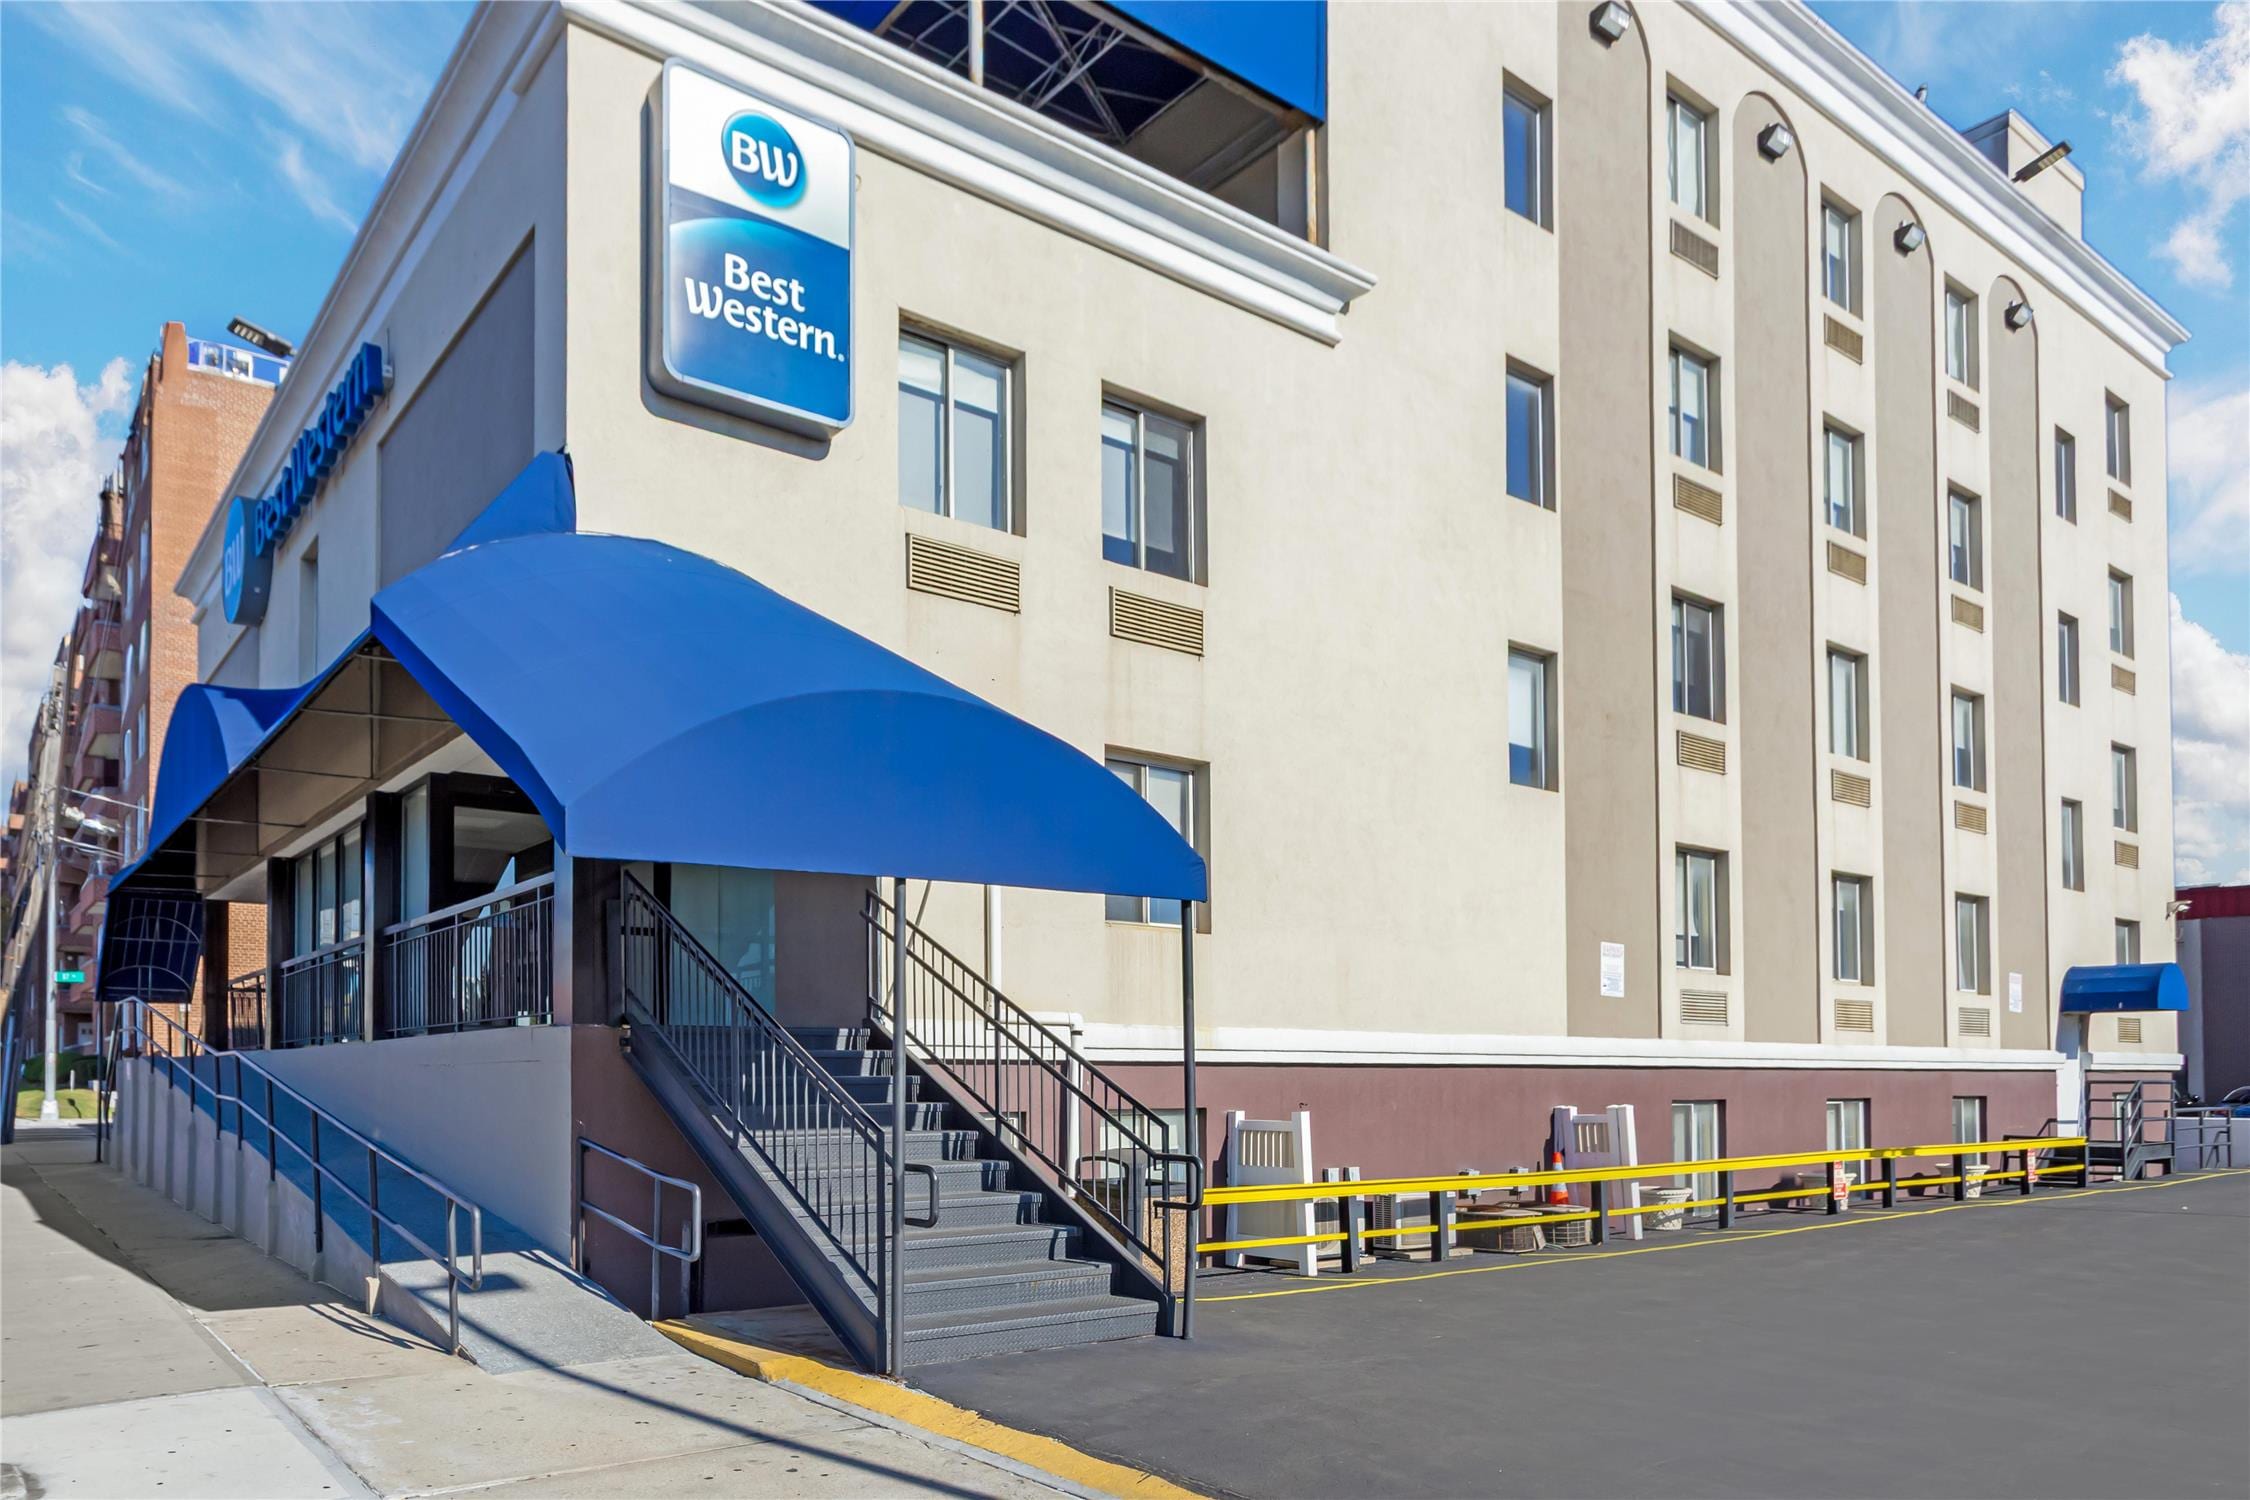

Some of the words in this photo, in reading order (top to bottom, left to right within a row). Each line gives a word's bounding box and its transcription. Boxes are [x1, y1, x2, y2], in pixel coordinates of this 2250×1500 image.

[731, 130, 798, 188] BW
[724, 252, 805, 313] Best
[255, 466, 298, 557] Best
[290, 341, 383, 506] Western
[224, 526, 245, 598] BW
